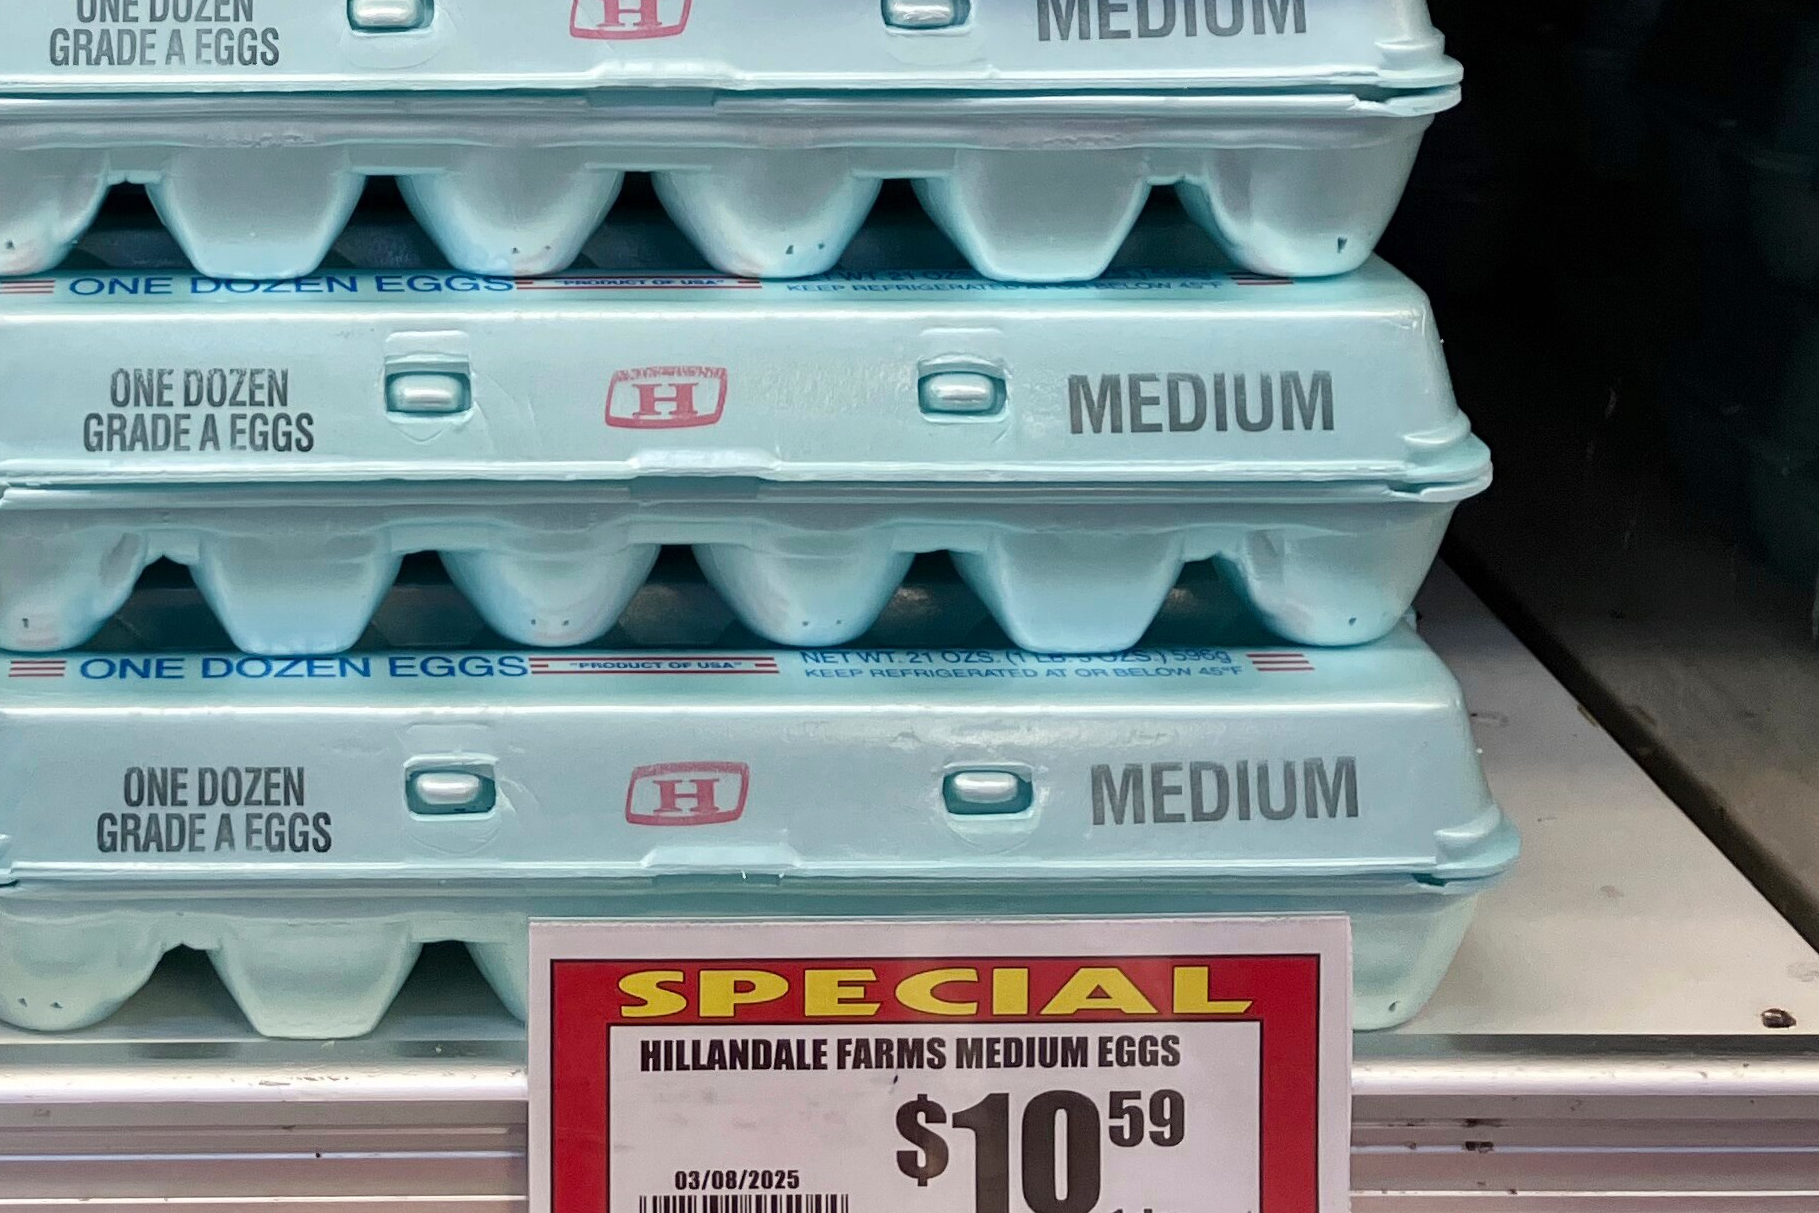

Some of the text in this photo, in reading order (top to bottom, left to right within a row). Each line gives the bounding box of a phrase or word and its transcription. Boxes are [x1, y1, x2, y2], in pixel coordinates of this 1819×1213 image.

[49, 27, 280, 67] GRADE A EGGS
[69, 274, 515, 296] ONE DOZEN EGGS
[109, 367, 289, 408] ONE DOZEN
[630, 382, 701, 420] H
[1067, 370, 1335, 435] MEDIUM
[83, 412, 314, 452] GRADE A EGGS
[81, 655, 529, 679] ONE DOZEN EGGS
[801, 651, 849, 663] NET
[907, 651, 935, 663] 21
[805, 668, 863, 677] KEEP
[869, 668, 1037, 677] REFRIGERATED
[1046, 668, 1067, 677] AT
[1075, 668, 1109, 677] OR
[1113, 667, 1191, 677] BELOW
[123, 765, 305, 808] ONE DOZEN
[652, 777, 720, 815] H
[1089, 756, 1360, 826] MEDIUM
[97, 812, 332, 853] GRADE A EGGS
[618, 966, 1254, 1018] SPECIAL
[639, 1035, 1181, 1072] HILLANDALE FARMS MEDIUM EGGS
[674, 1169, 800, 1191] 03/08/2025
